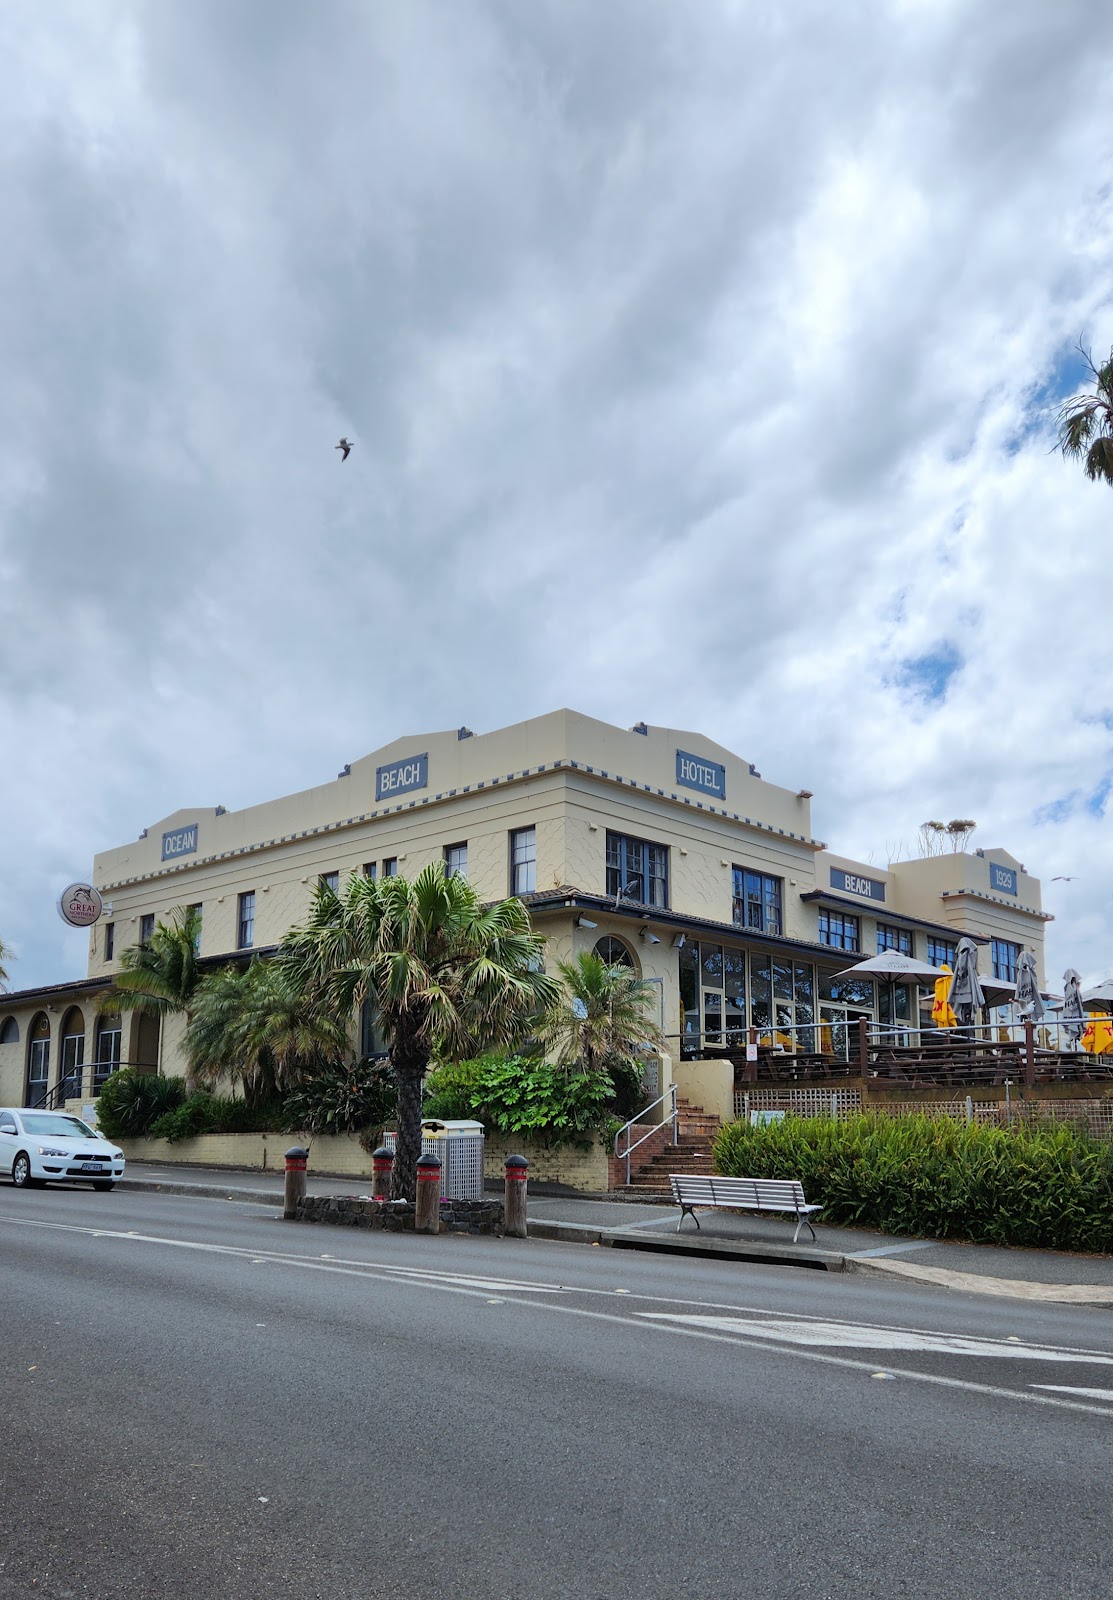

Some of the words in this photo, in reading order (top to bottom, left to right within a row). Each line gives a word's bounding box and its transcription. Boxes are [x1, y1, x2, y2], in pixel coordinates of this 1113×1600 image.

[380, 762, 420, 792] BEACH
[680, 758, 720, 790] HOTEL
[165, 830, 195, 855] OCEAN
[844, 875, 871, 897] BEACH
[995, 869, 1012, 888] 1929
[69, 903, 96, 913] GREAT
